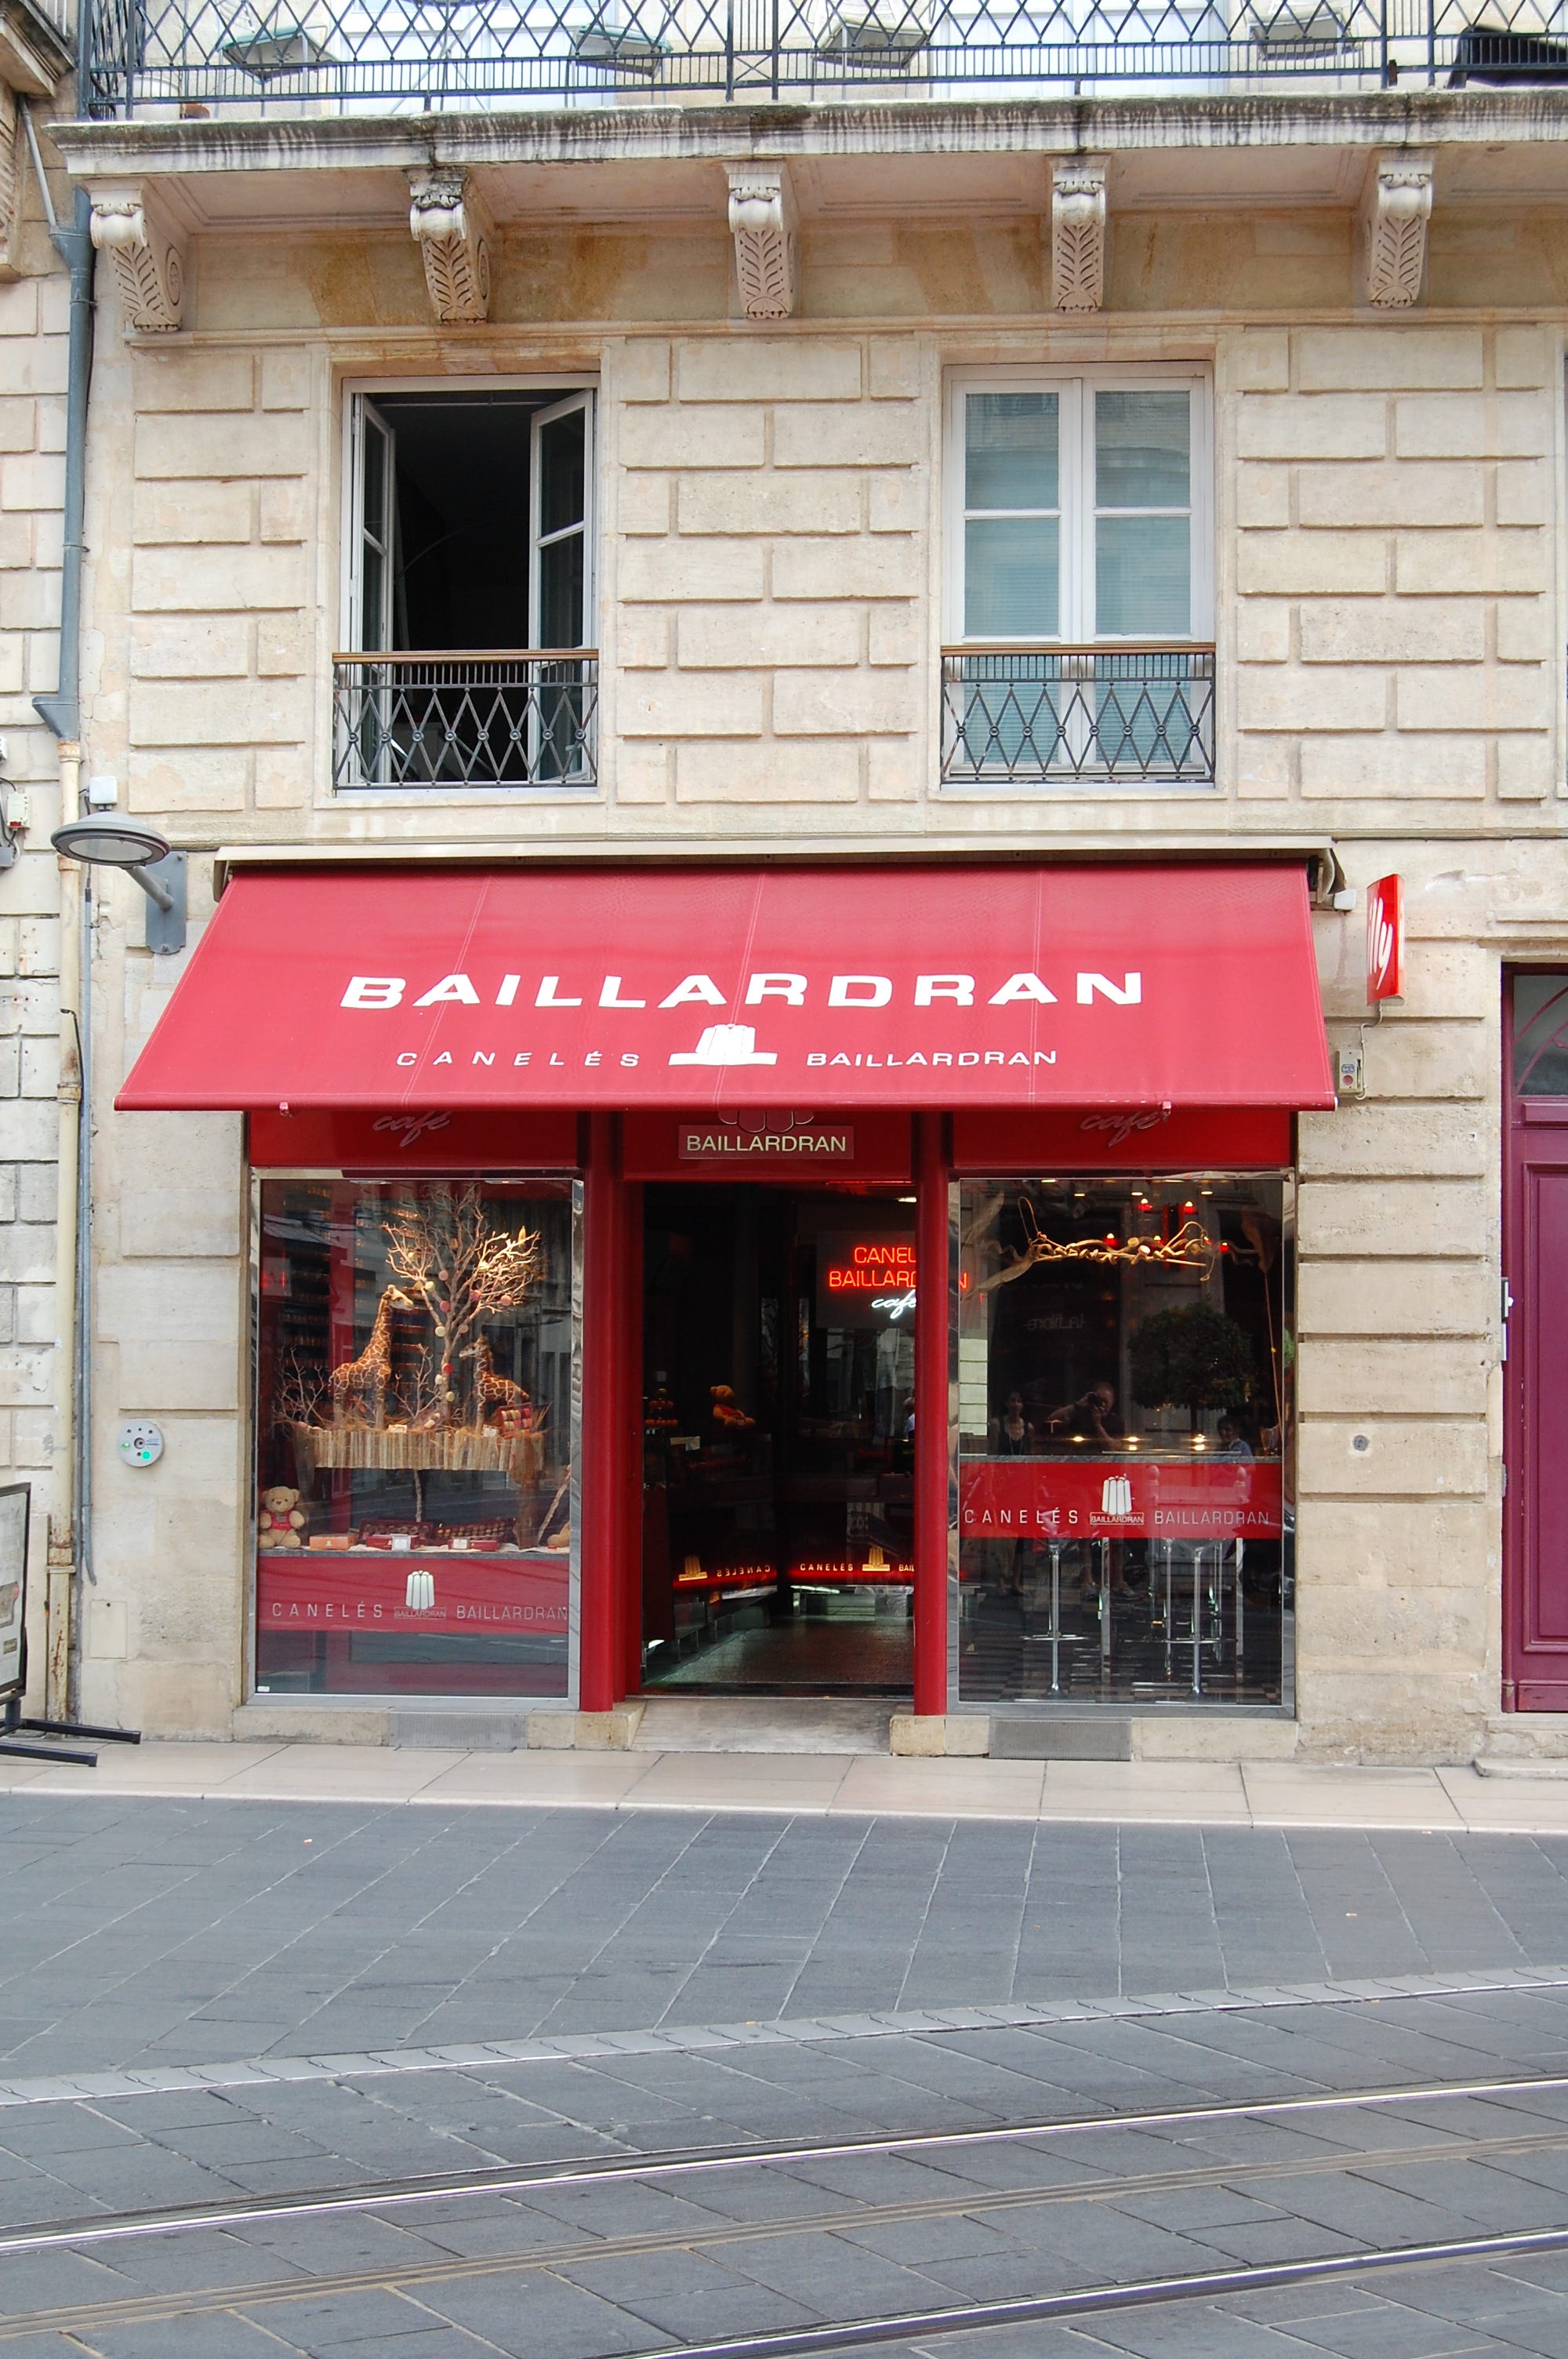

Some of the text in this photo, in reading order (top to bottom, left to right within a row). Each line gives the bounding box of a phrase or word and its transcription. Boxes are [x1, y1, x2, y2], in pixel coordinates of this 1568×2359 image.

[339, 972, 1142, 1009] BAILLARDRAN
[396, 1050, 1056, 1067] CANELÉS BAILLARDRAN
[686, 1136, 846, 1151] BAILLARDRAN
[854, 1247, 916, 1263] CANEL
[964, 1507, 1269, 1525] CANELÉS BAILLARDRAN
[1091, 1514, 1143, 1524] BAILLARDRAN
[272, 1601, 568, 1620] CANELÉS BAILLARDRAN
